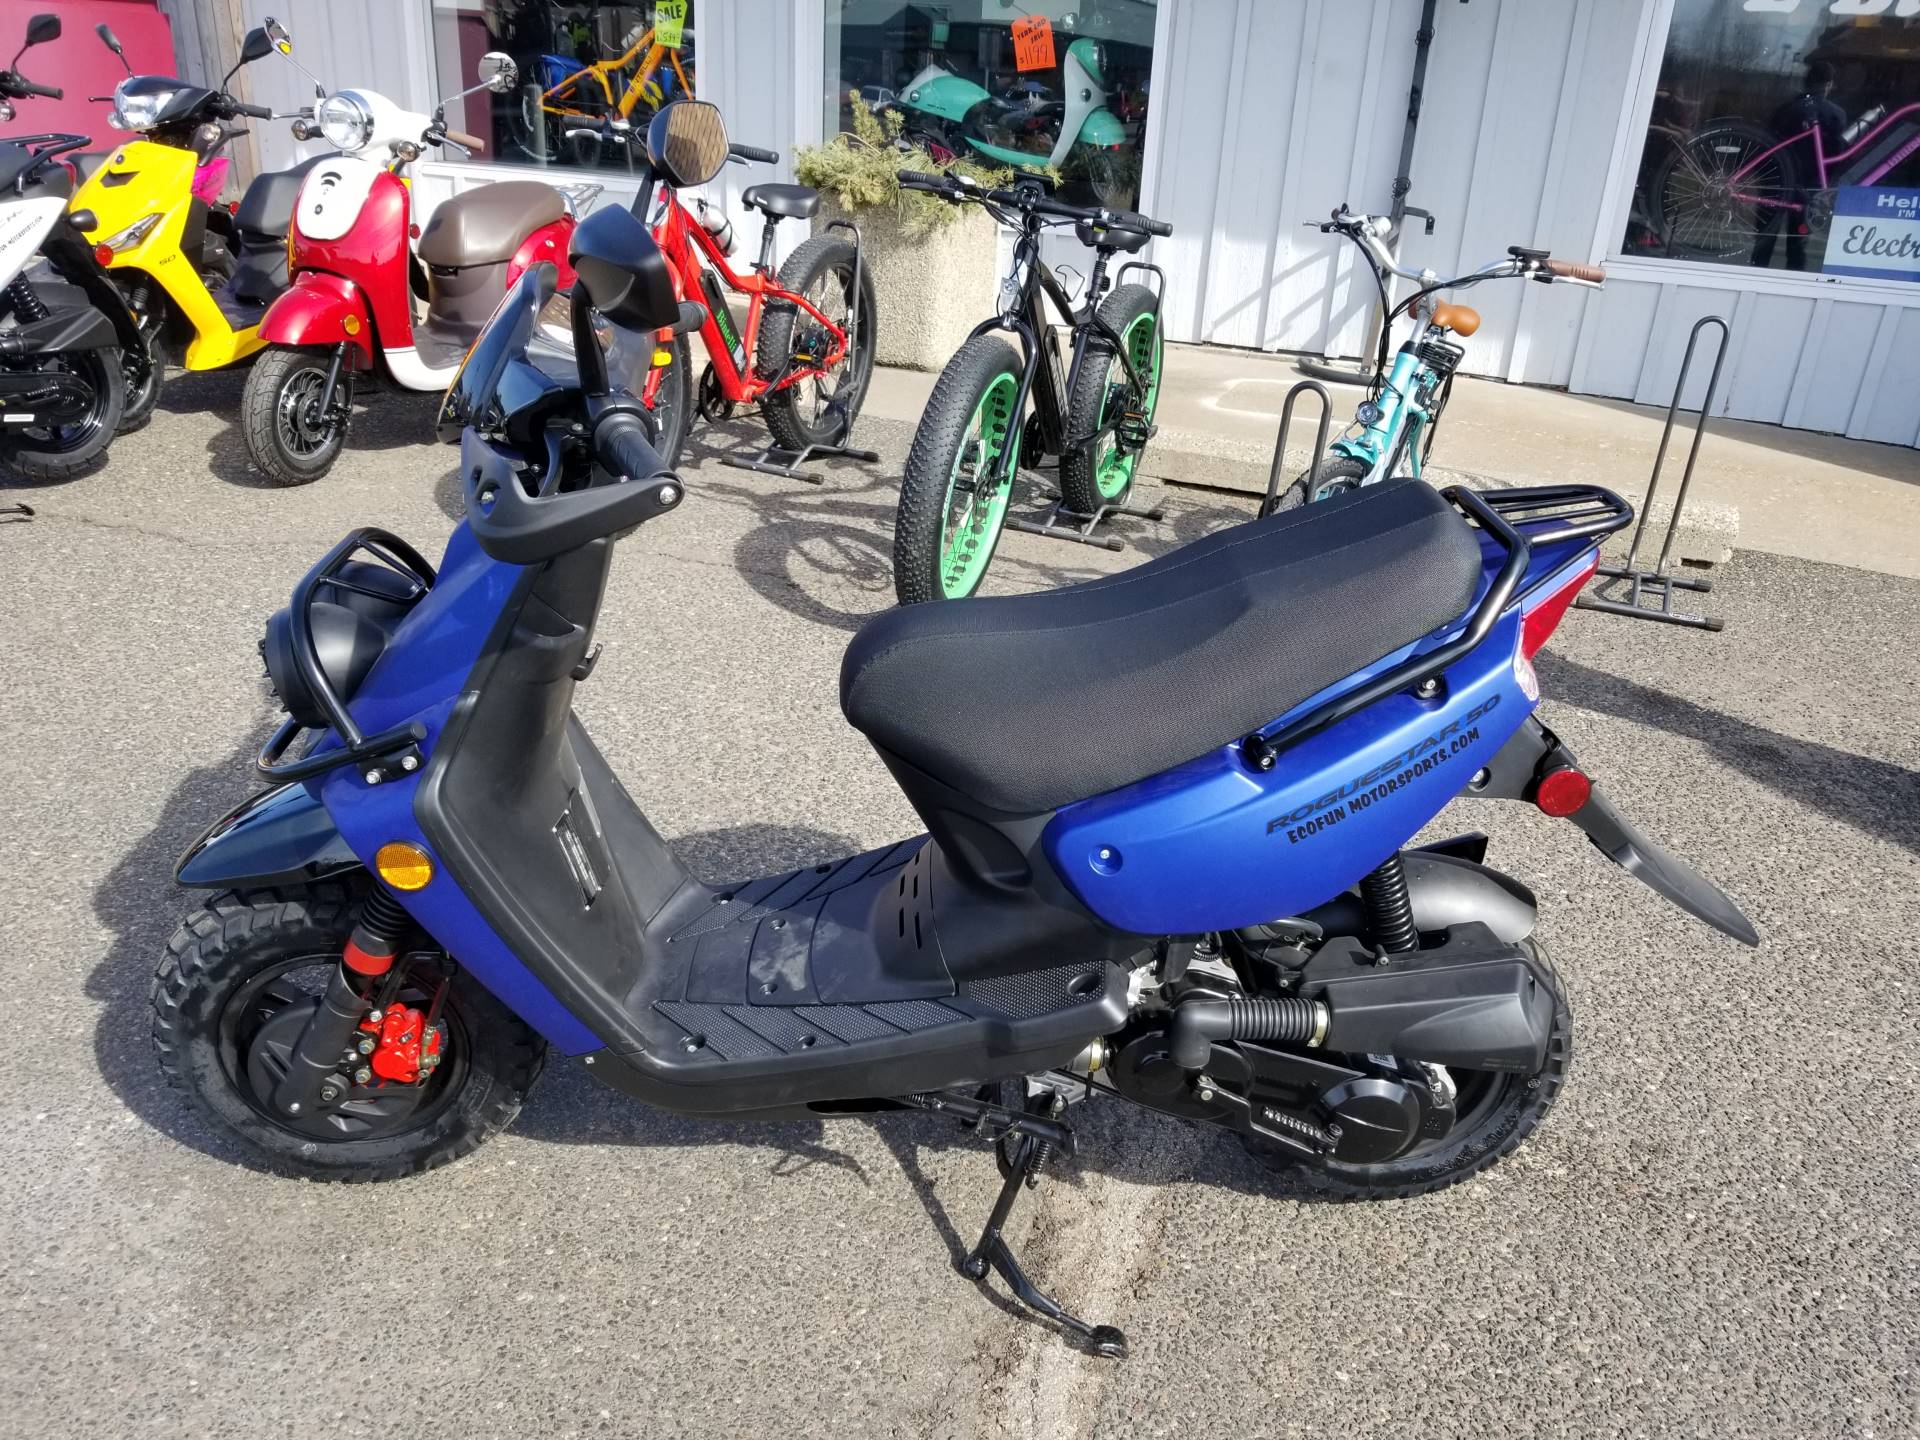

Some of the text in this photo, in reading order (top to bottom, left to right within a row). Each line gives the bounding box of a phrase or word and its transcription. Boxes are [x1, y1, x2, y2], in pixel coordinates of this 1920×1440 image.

[657, 4, 682, 23] SALE
[1877, 194, 1920, 209] Hel
[1897, 209, 1916, 218] I'M
[716, 307, 737, 353] Bintelli
[1266, 693, 1502, 836] ROGUESTAR 50
[1286, 727, 1480, 844] ECOFUN MOTORSPORTS.COM
